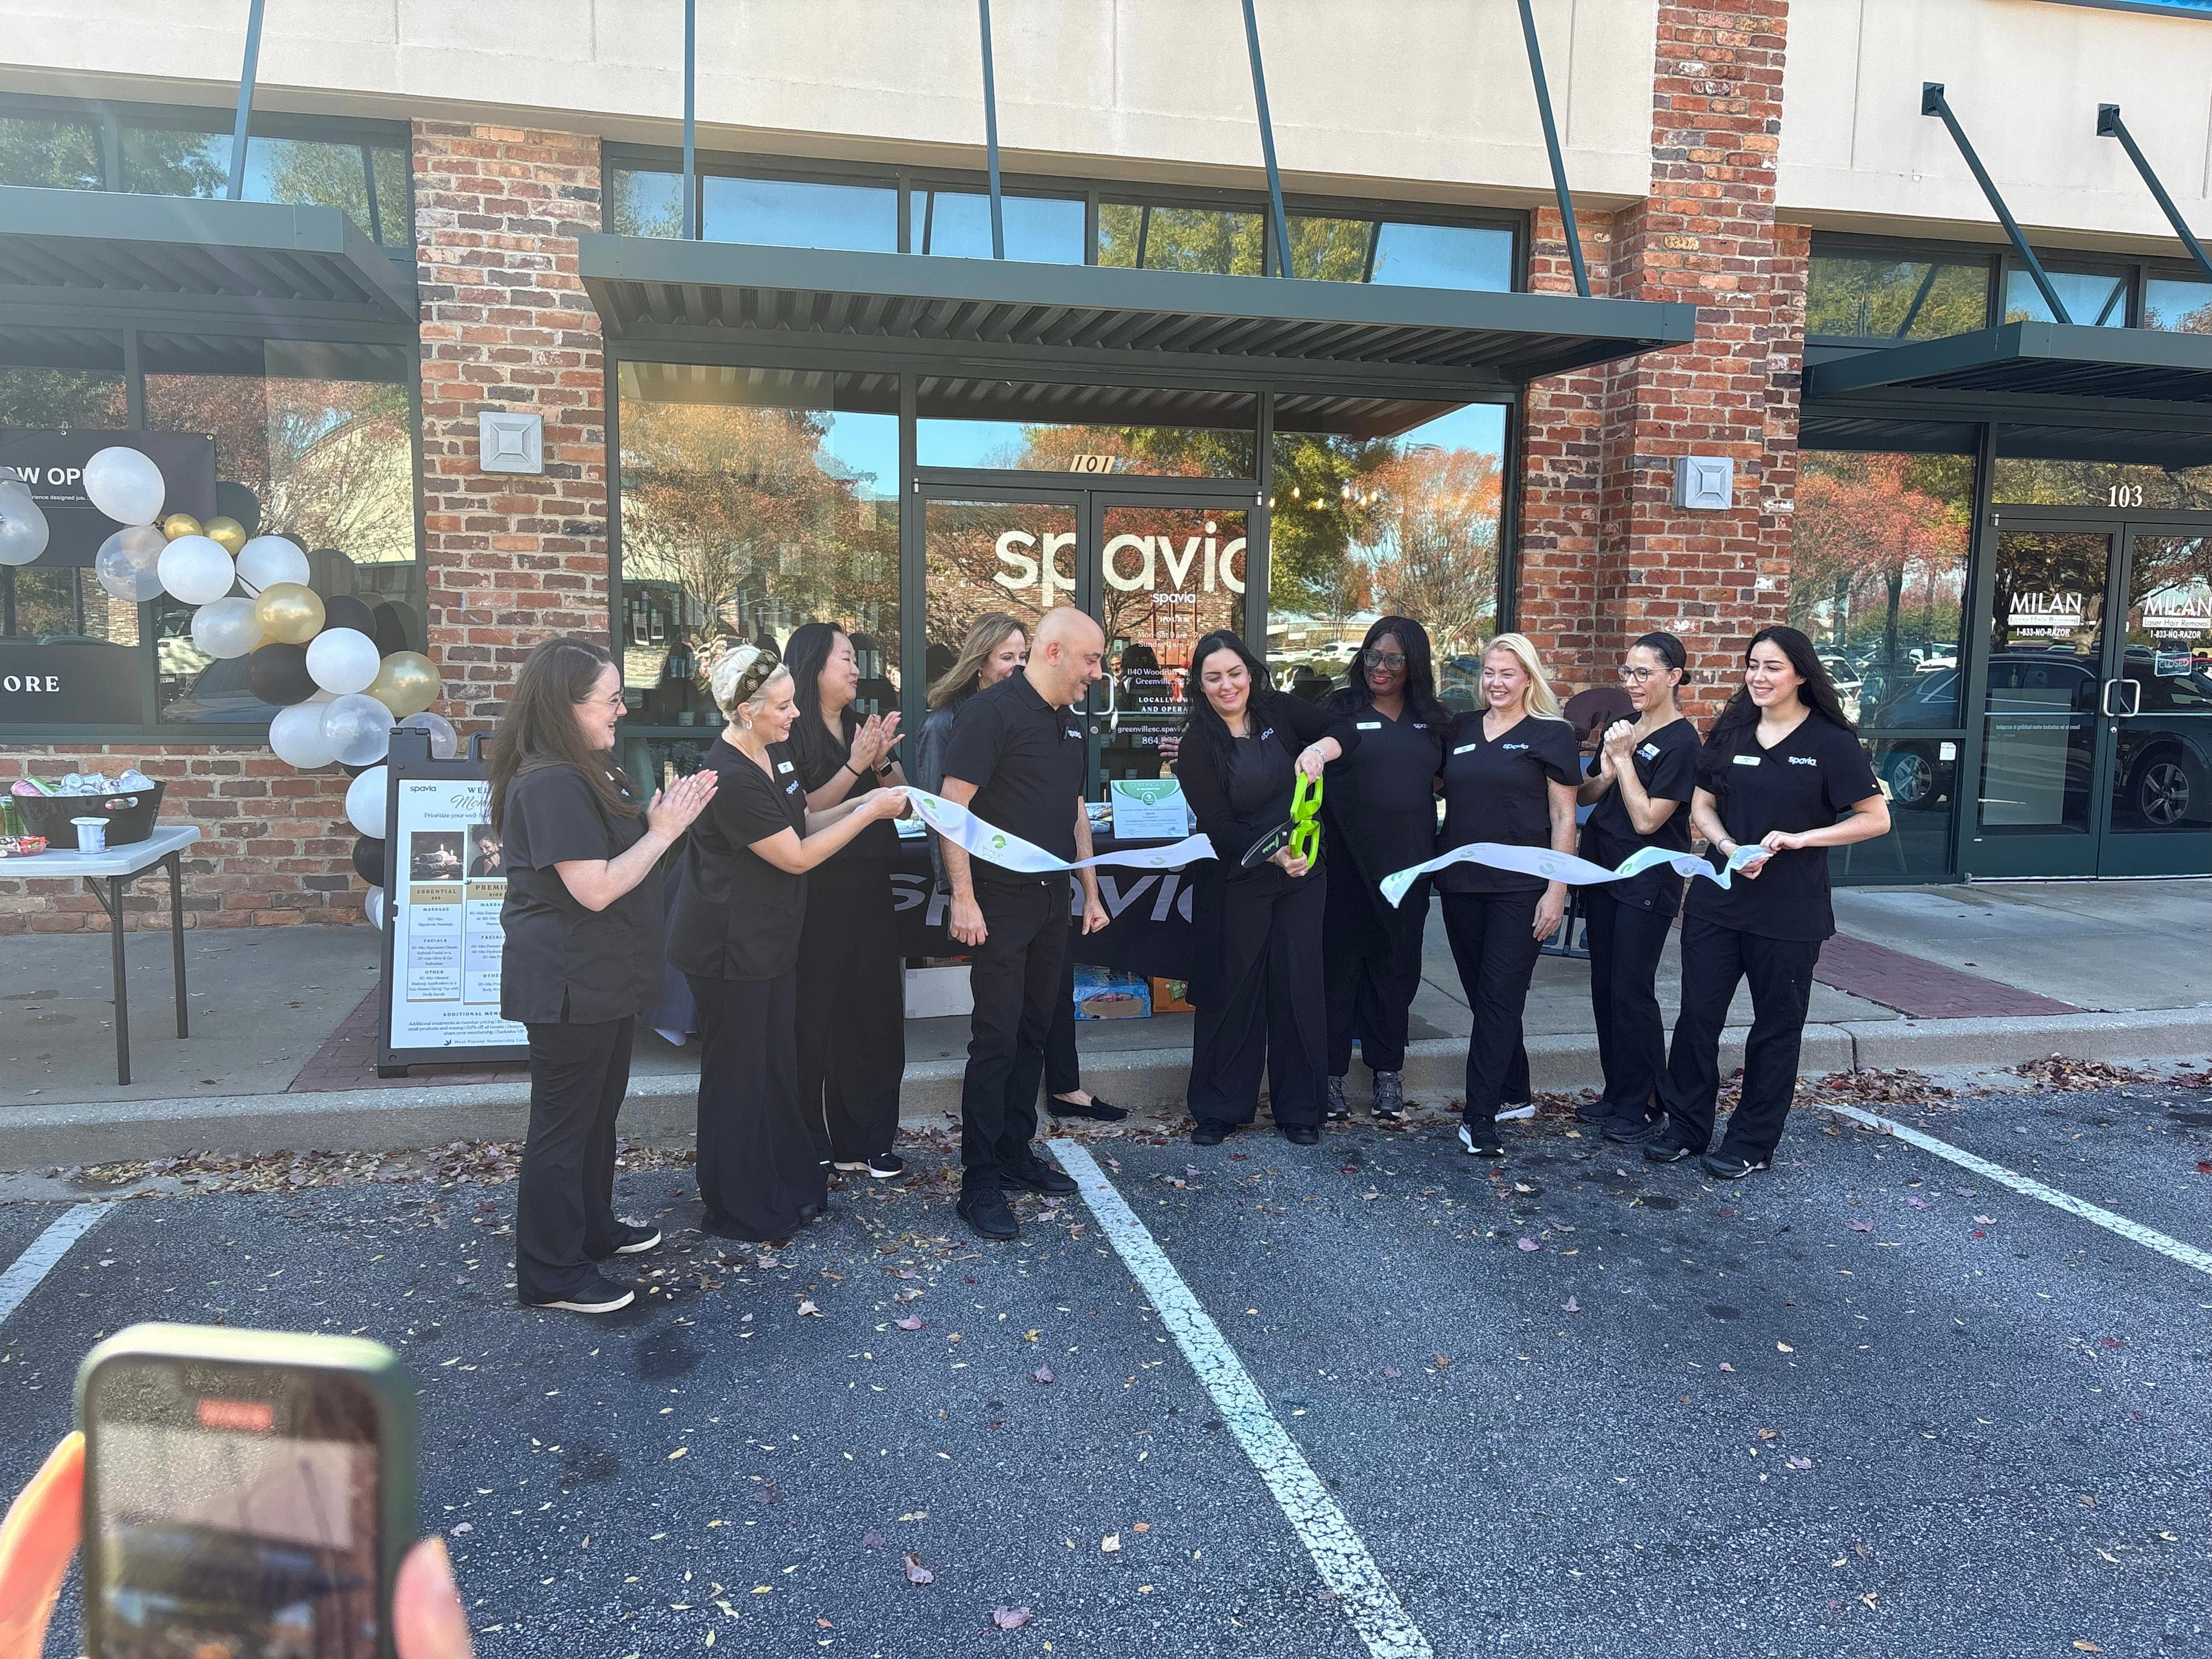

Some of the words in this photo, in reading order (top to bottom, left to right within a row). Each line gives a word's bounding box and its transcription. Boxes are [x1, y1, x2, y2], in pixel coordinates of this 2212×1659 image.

[1074, 455, 1110, 472] 101
[47, 467, 85, 485] OP
[2108, 485, 2142, 508] 103
[1153, 591, 1196, 606] spavia
[2009, 592, 2081, 614] MILAN
[2144, 595, 2212, 616] MILAN
[2017, 628, 2071, 636] 1-833-NO-RAZOR
[2151, 630, 2201, 639] 1-833-NO-RAZOR
[1138, 640, 1165, 649] Sunday
[2158, 659, 2189, 669] CLOSED
[3, 675, 60, 692] ORE
[1261, 727, 1274, 741] spa
[1788, 756, 1817, 766] spavia
